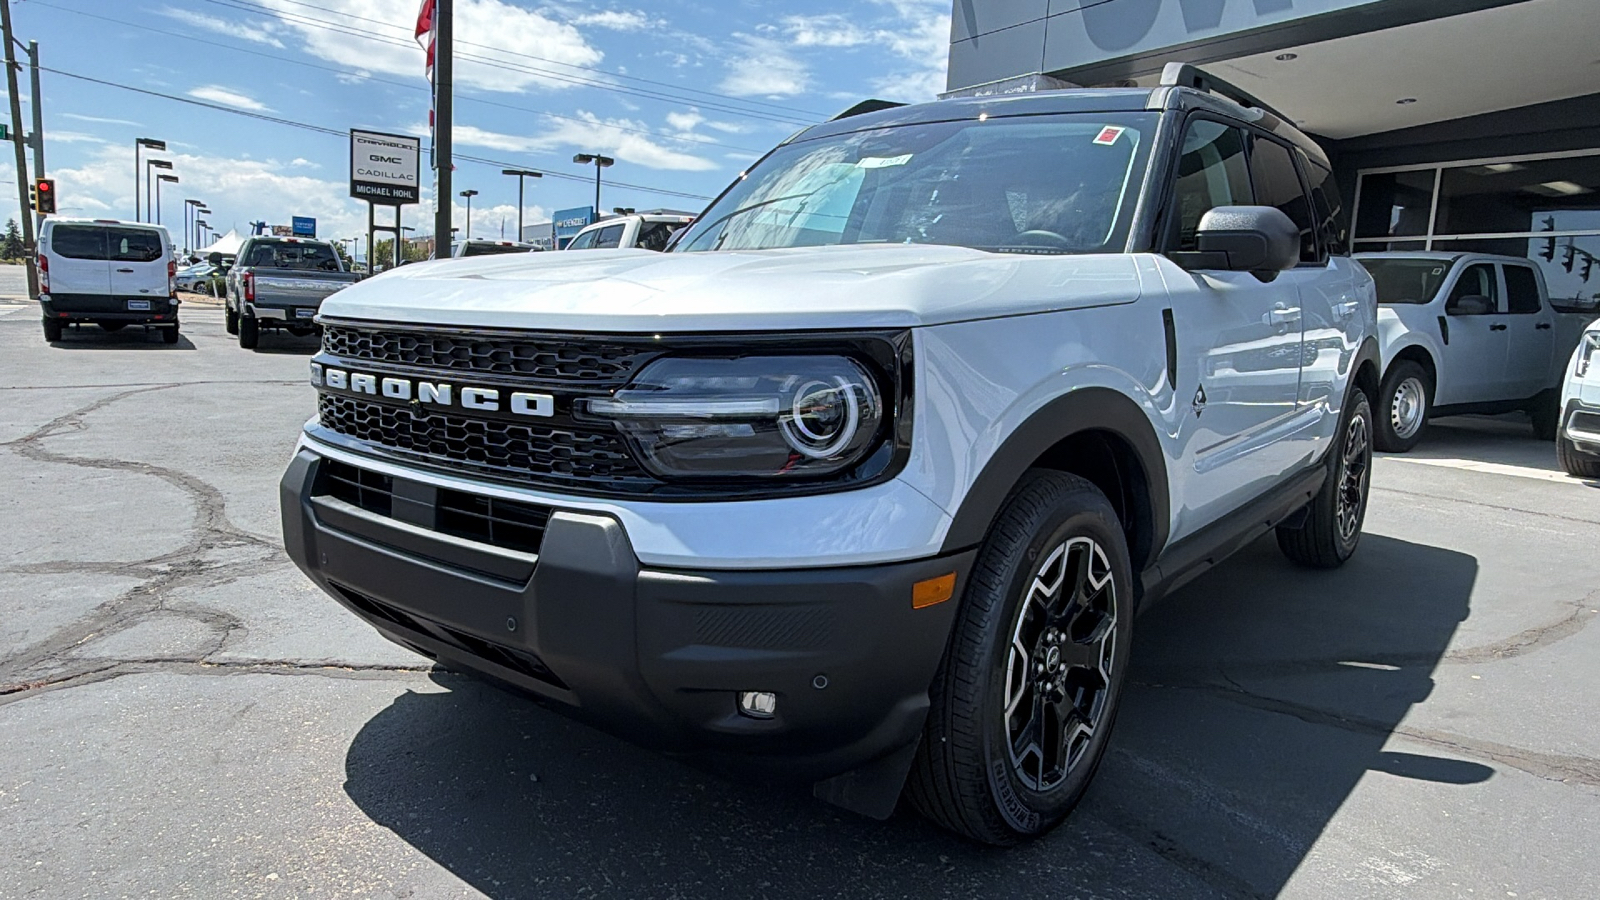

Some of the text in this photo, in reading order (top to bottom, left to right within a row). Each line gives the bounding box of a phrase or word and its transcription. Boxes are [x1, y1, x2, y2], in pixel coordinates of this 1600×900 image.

[357, 138, 414, 150] CHEVROLET
[369, 154, 402, 165] GMC
[357, 168, 414, 180] CADILLAC
[356, 185, 413, 199] MICHAEL HOHL
[326, 368, 554, 417] BRONCO
[995, 763, 1028, 823] MICHELIN
